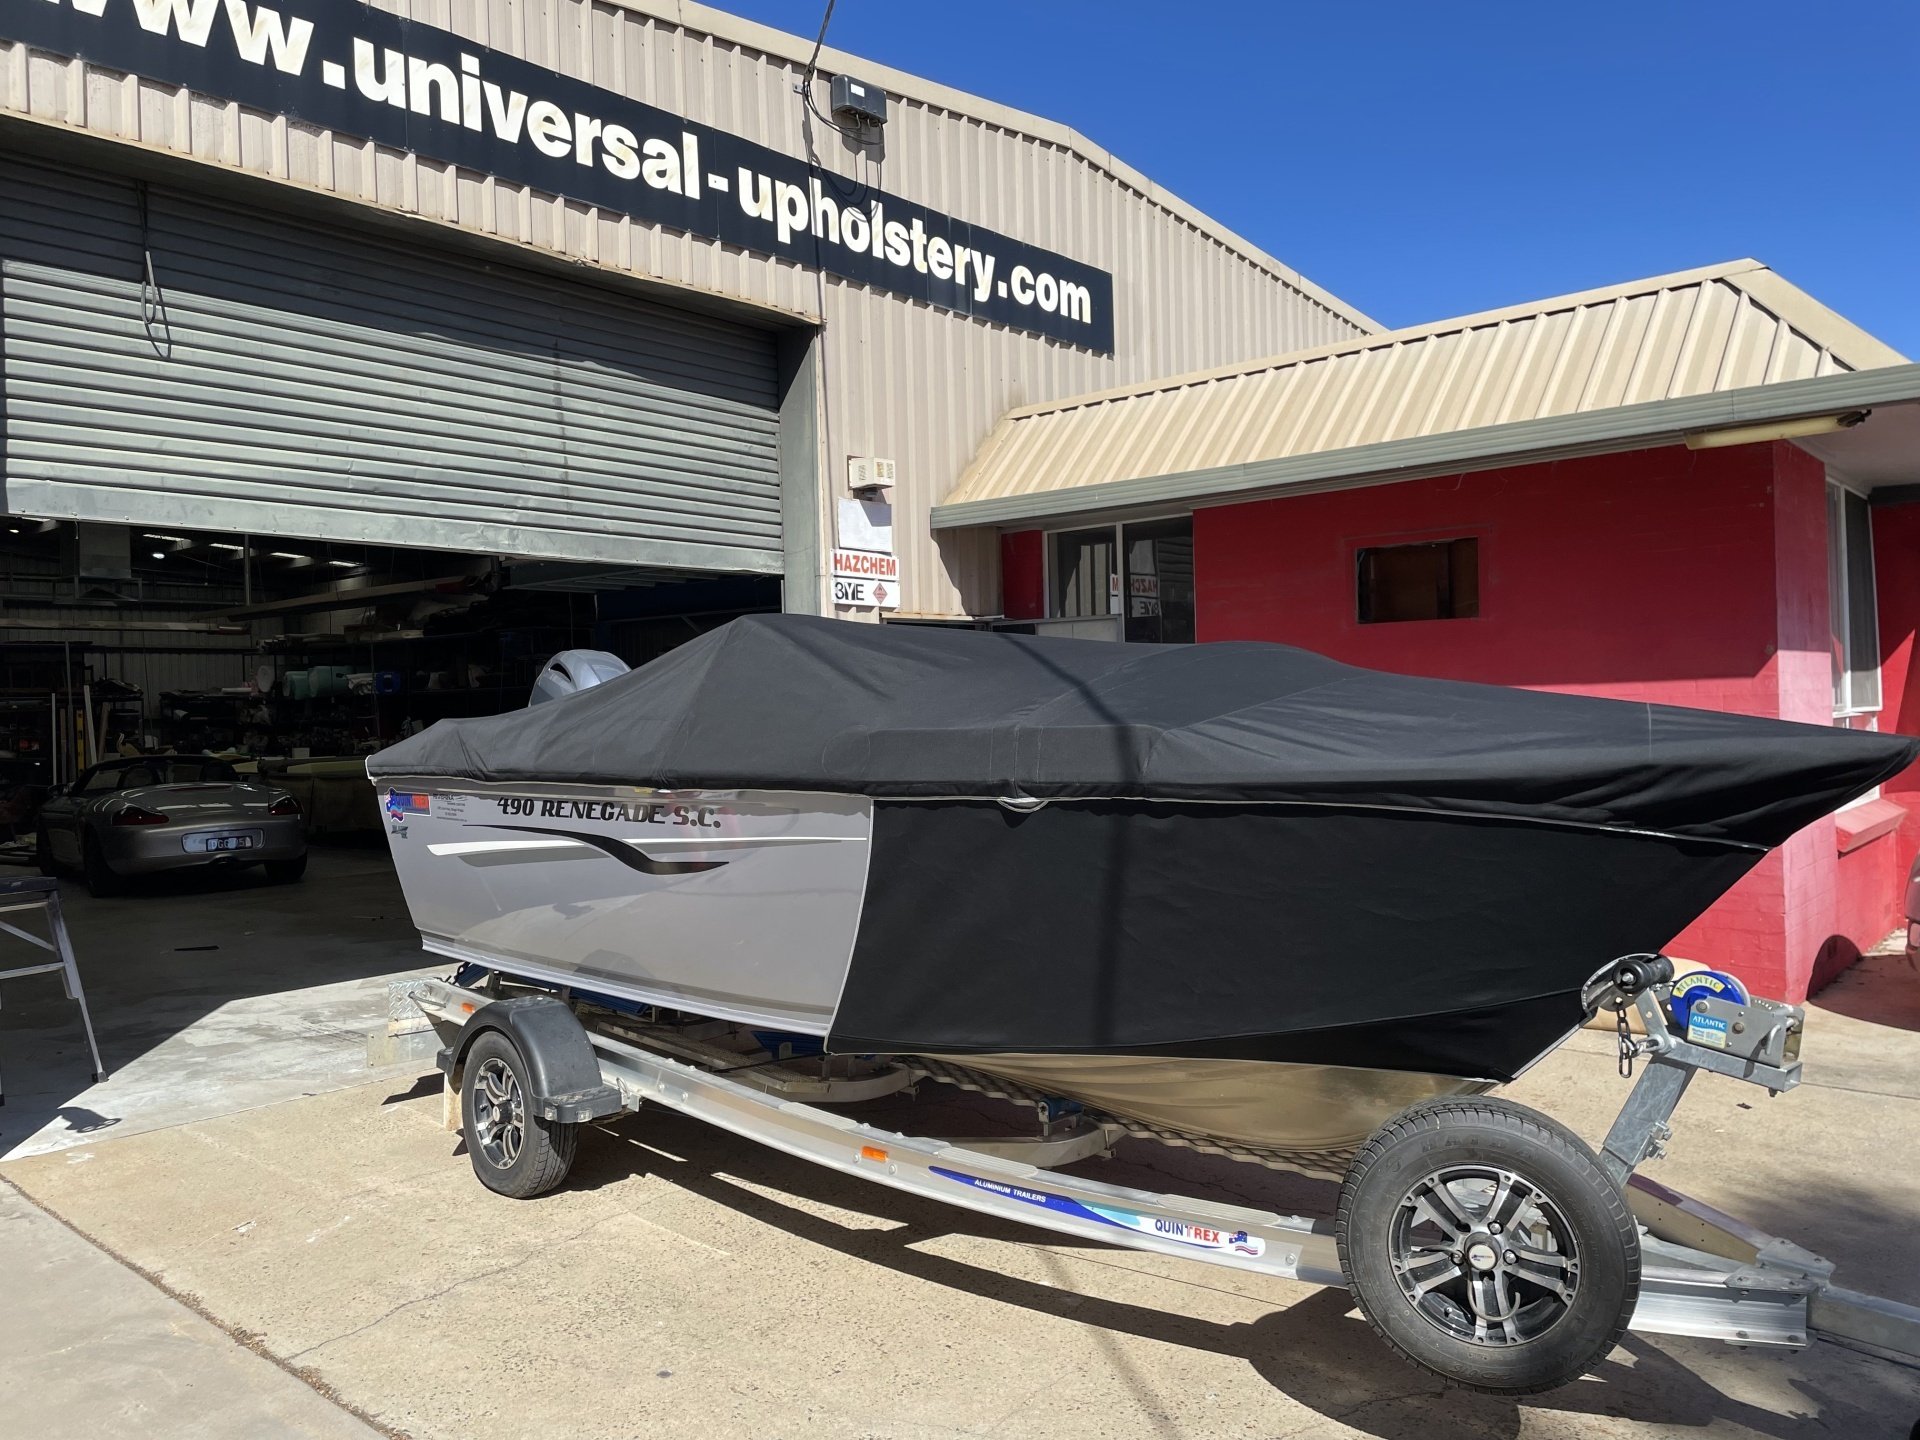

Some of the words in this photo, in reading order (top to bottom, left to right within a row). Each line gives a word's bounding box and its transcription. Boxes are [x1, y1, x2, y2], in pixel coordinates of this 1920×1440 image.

[44, 0, 1091, 324] ww.universal-upholstery.com
[834, 552, 896, 576] HAZCHEM
[835, 582, 864, 601] 3YE
[497, 797, 534, 816] 490
[540, 800, 665, 824] RENEGADE
[673, 805, 721, 828] S.C.
[1676, 976, 1720, 993] ATLANTIC
[1692, 1015, 1726, 1030] ATLANTIC
[974, 1179, 1011, 1194] ALUMINIUM
[1013, 1188, 1047, 1203] TRAILERS
[1155, 1219, 1220, 1243] QUINTREX
